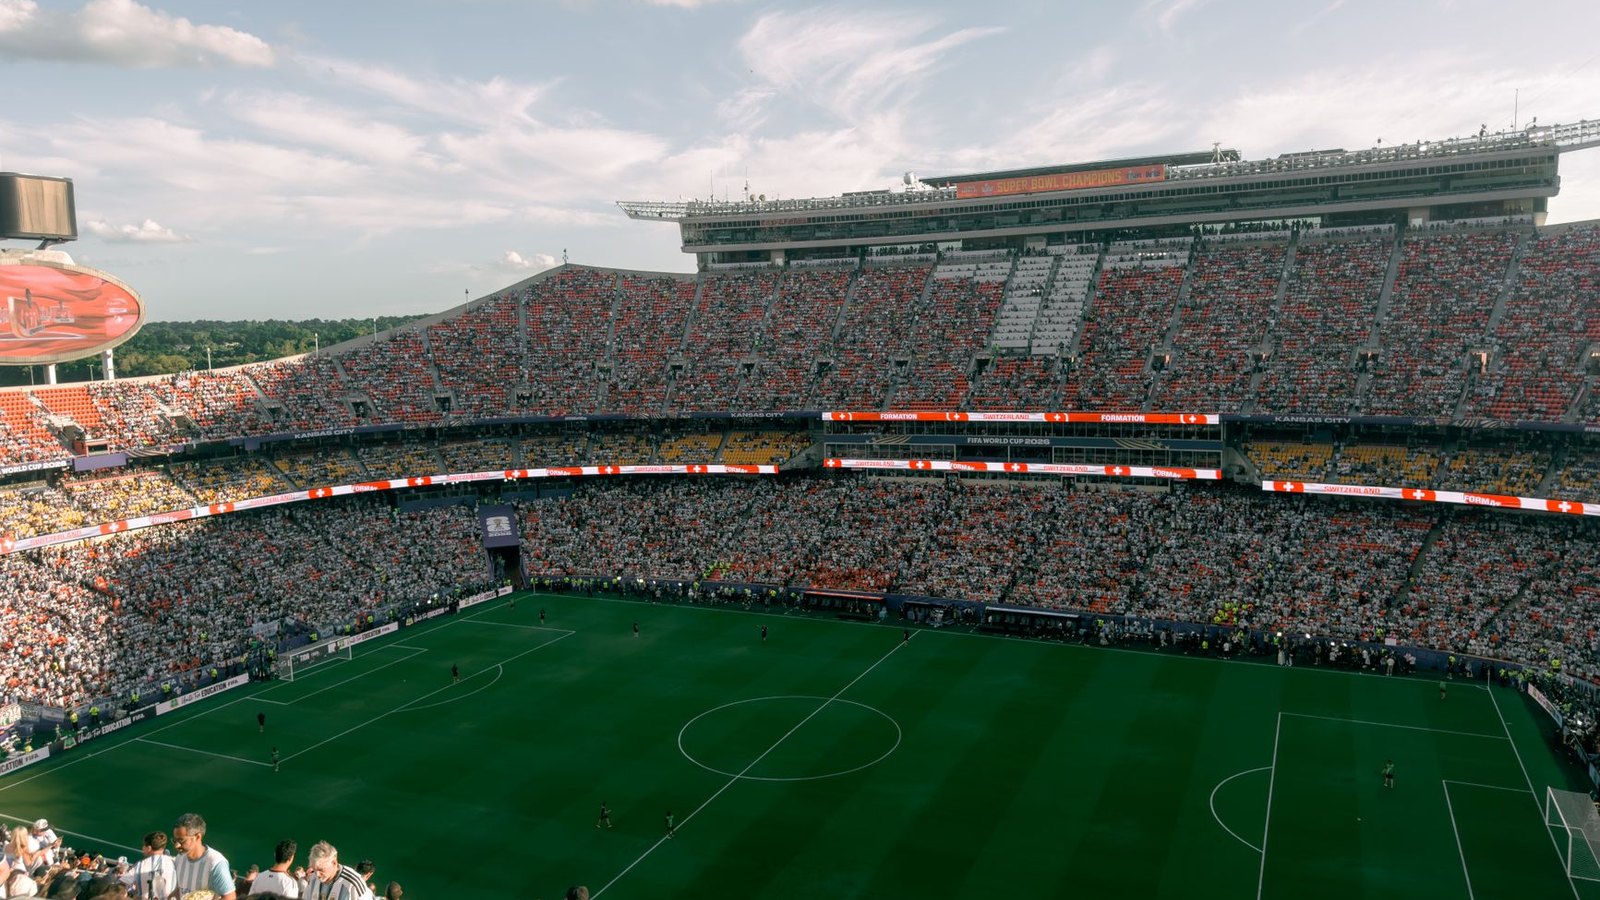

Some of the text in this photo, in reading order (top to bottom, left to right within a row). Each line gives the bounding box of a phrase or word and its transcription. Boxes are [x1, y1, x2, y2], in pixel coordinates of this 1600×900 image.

[997, 178, 1028, 193] SUPER
[1031, 175, 1059, 190] BOWL
[1062, 171, 1122, 188] CHAMPIONS
[1101, 414, 1145, 422] FORMATION
[295, 430, 333, 439] KANSAS
[1, 460, 67, 474] WORLD CUP 2026
[1323, 486, 1381, 495] SWITZERLAND
[201, 683, 227, 698] EDUCATION
[227, 679, 238, 688] FIFA
[101, 717, 132, 735] EDUCATION
[132, 713, 145, 722] FIFA
[0, 753, 40, 774] CATION FIFA
